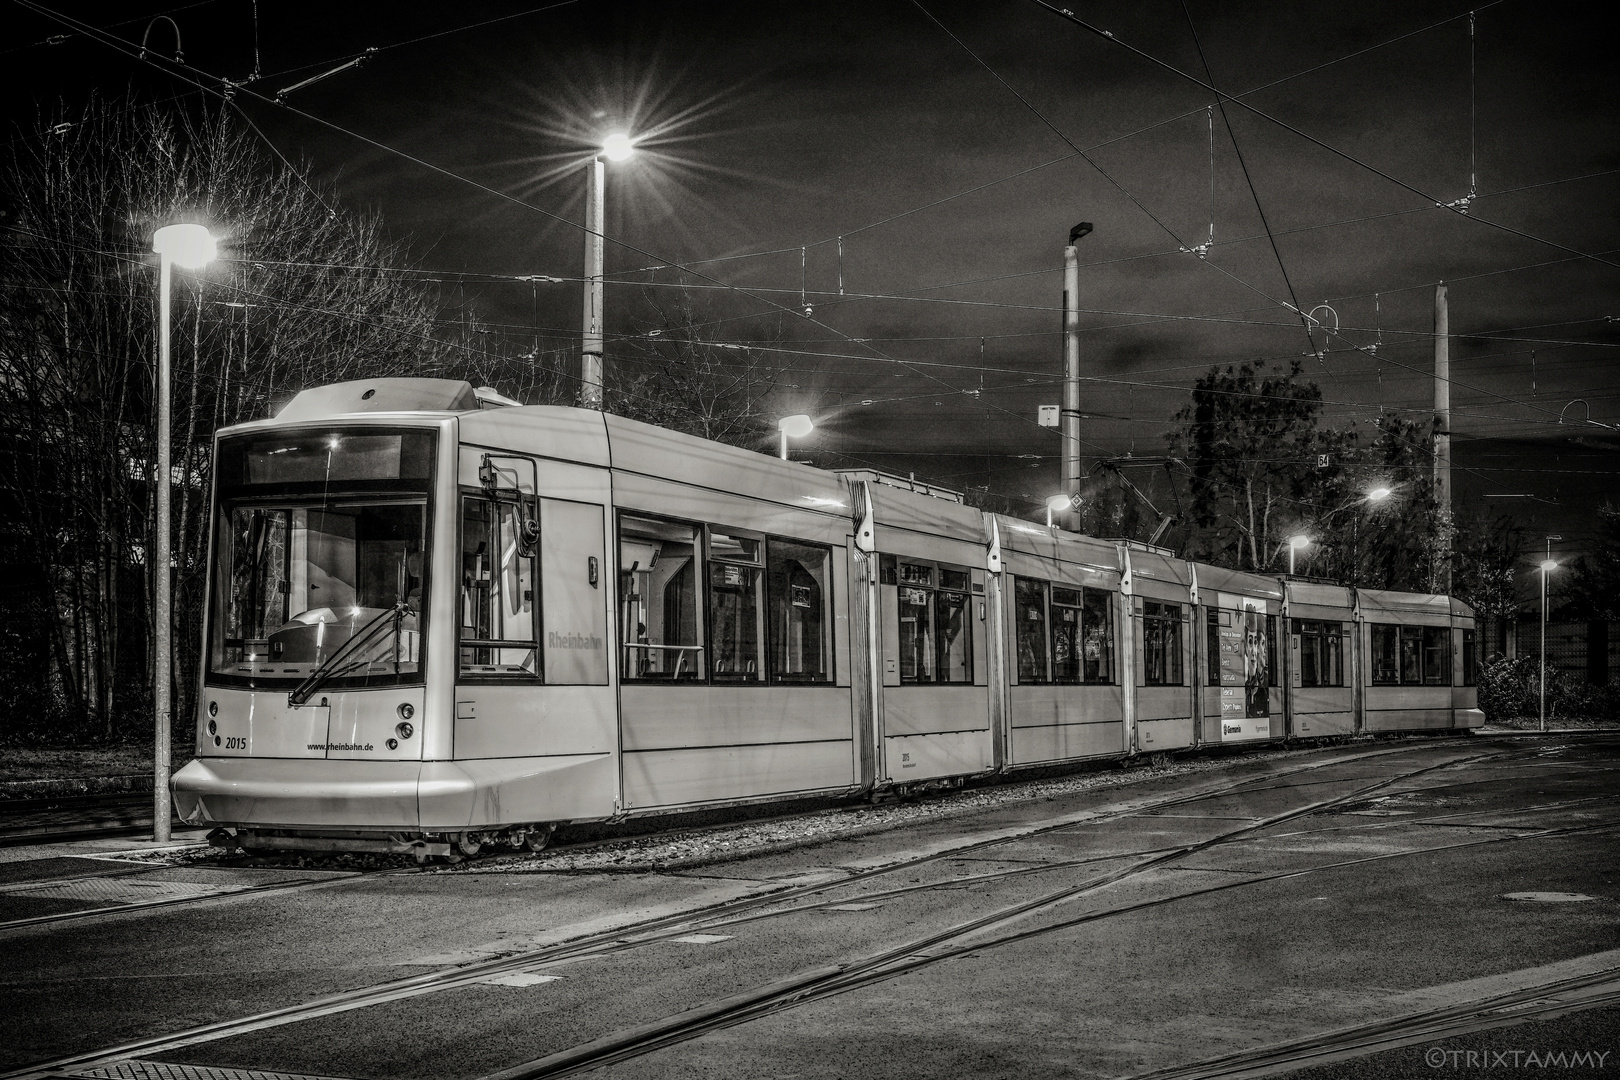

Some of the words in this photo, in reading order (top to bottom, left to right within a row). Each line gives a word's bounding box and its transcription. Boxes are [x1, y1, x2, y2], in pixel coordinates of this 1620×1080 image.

[1319, 455, 1328, 466] 64
[548, 631, 603, 650] Rheinbahn
[225, 736, 247, 750] 2015
[307, 742, 374, 751] www.rheinbahn.de
